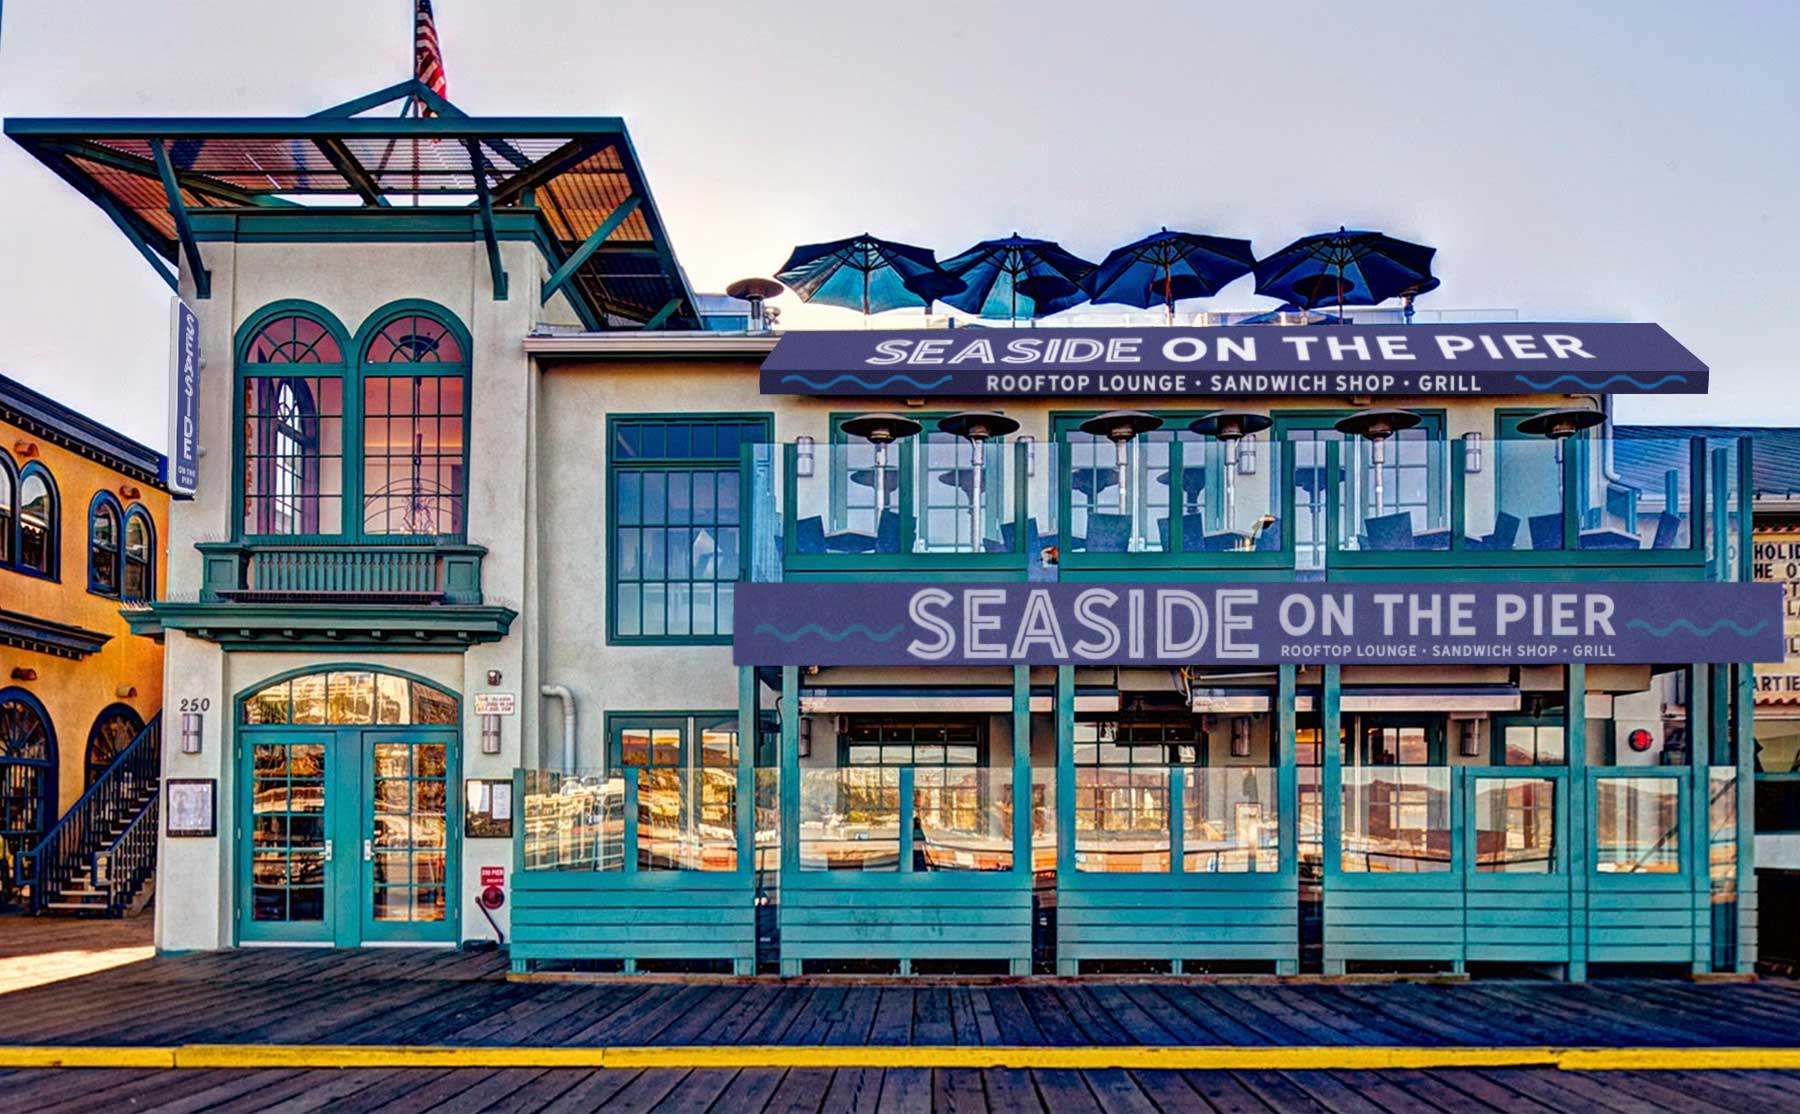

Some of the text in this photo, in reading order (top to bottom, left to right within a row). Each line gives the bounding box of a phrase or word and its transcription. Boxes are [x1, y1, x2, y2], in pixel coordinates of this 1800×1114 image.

[865, 335, 1597, 365] SEASIDE ON THE PIER
[184, 313, 195, 461] SEASIDE
[987, 375, 1482, 393] ROOFTOP LOUNGE SANDWICH SHOP GRILL
[907, 587, 1616, 661] SEASIDE ON THE PIER
[1281, 644, 1616, 657] ROOFTOP LOUNGE SANDWICH SHOP GRILL
[179, 698, 210, 712] 250
